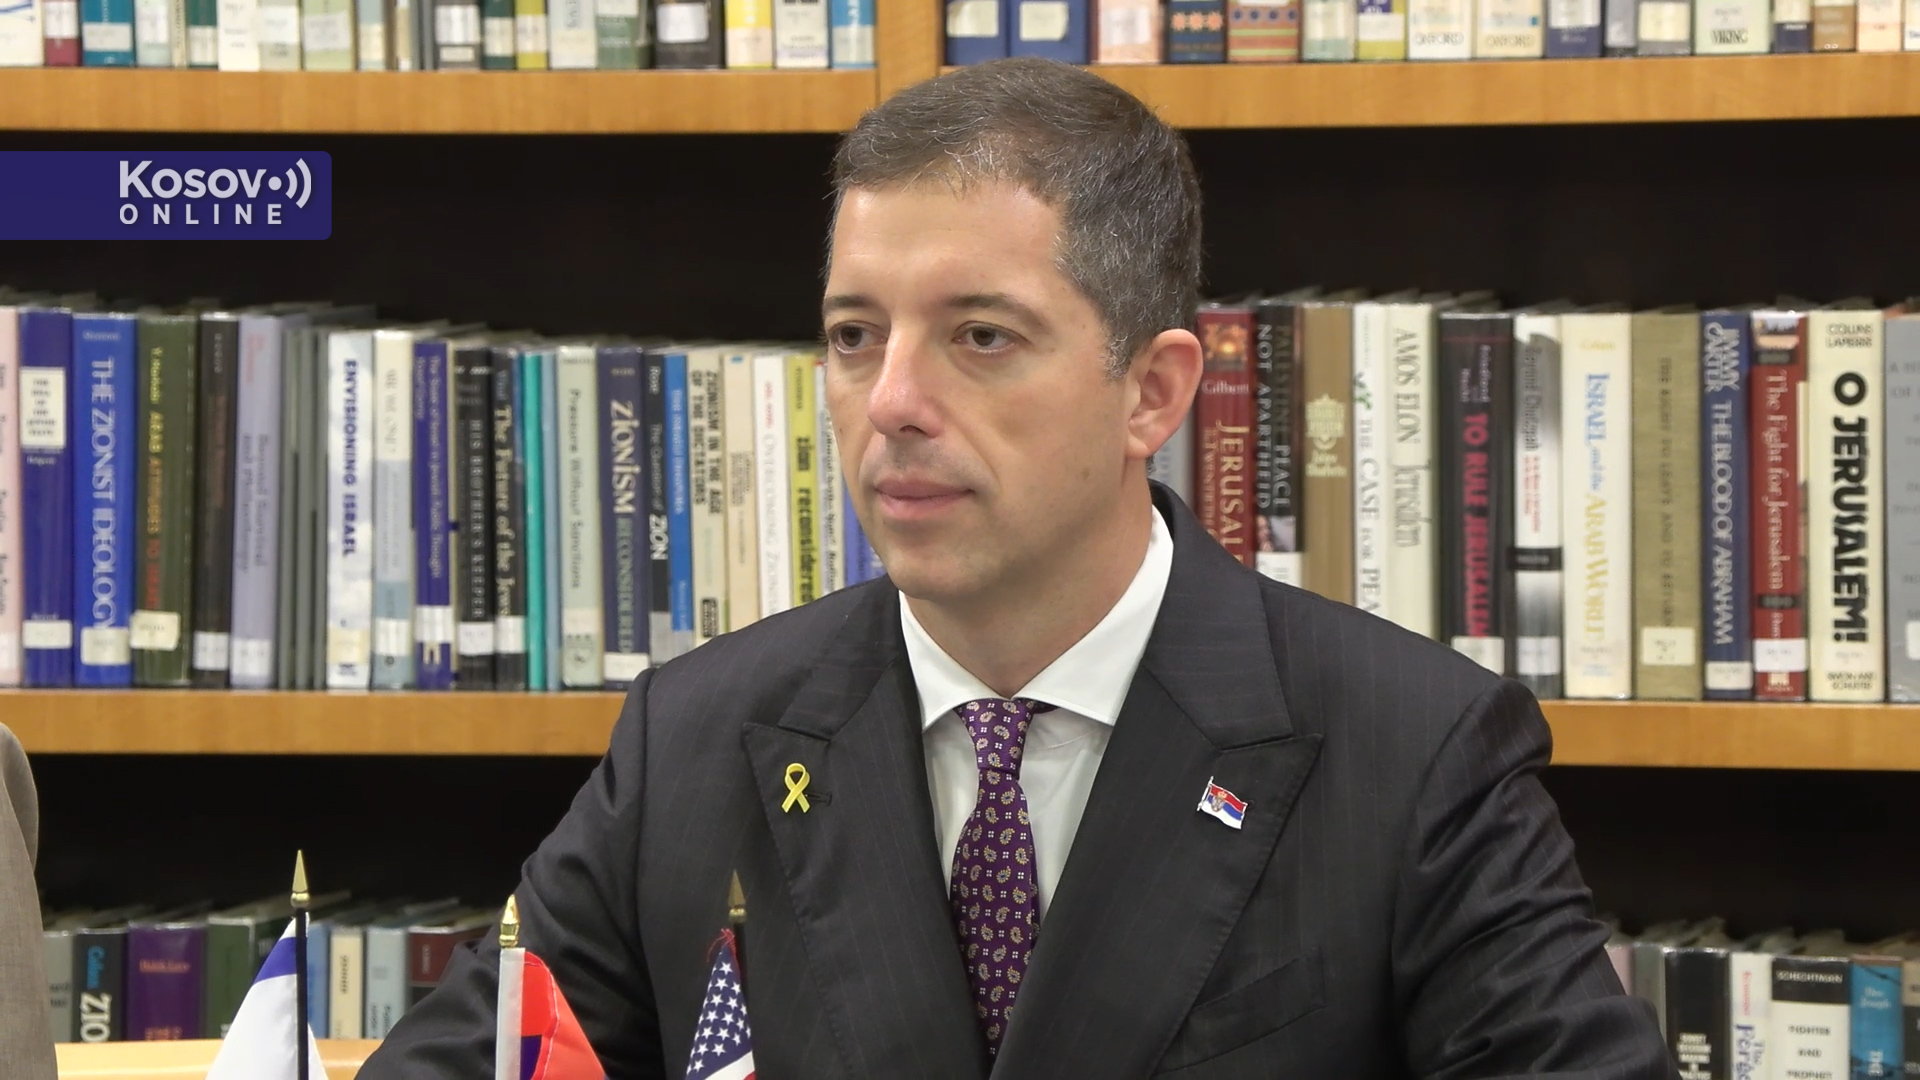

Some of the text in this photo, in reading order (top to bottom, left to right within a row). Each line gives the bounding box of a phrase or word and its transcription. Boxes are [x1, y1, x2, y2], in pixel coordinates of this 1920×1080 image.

[1414, 31, 1465, 45] OXFORD
[1486, 34, 1536, 47] OXFORD
[1710, 29, 1748, 44] VIKING
[1394, 327, 1420, 386] AMOS
[1705, 322, 1723, 393] CARTER
[1720, 328, 1740, 390] JIMMY
[1825, 324, 1873, 335] COLLINS
[91, 356, 115, 404] THE
[648, 366, 661, 394] Rose
[692, 370, 704, 387] OF
[692, 395, 705, 419] THE
[706, 370, 719, 431] ZIONISM
[1585, 372, 1611, 441] ISRAEL
[149, 411, 164, 453] ARAB
[471, 419, 485, 449] HIS
[708, 436, 720, 452] IN
[1256, 324, 1272, 509] NOT APARTHEID
[1360, 418, 1373, 450] THE
[1396, 393, 1421, 444] ELON
[91, 407, 116, 501] ZIONIST
[342, 360, 358, 557] ENVISIONING ISRAEL
[708, 458, 720, 482] THE
[1273, 443, 1291, 508] PEACE
[1762, 370, 1790, 590] The Fight for Jerusalem
[471, 455, 485, 549] BROTHER'S
[495, 405, 516, 616] The Future of the Jews
[568, 388, 584, 589] Pressure Without Sanctions
[708, 488, 722, 514] AGE
[796, 436, 816, 603] zion reconsidered
[1361, 457, 1381, 521] CASE
[1832, 372, 1870, 643] O JERUSALEM!
[650, 514, 668, 560] ZION
[1361, 527, 1374, 560] FOR
[1464, 413, 1490, 637] TO RULE JERUSALEM
[1584, 494, 1607, 557] ARAB
[1711, 399, 1734, 644] THE BLOOD OF ABRAHAM
[472, 554, 485, 618] KEEPER
[617, 517, 635, 653] RECONSIDERED
[1584, 556, 1609, 641] WORLD
